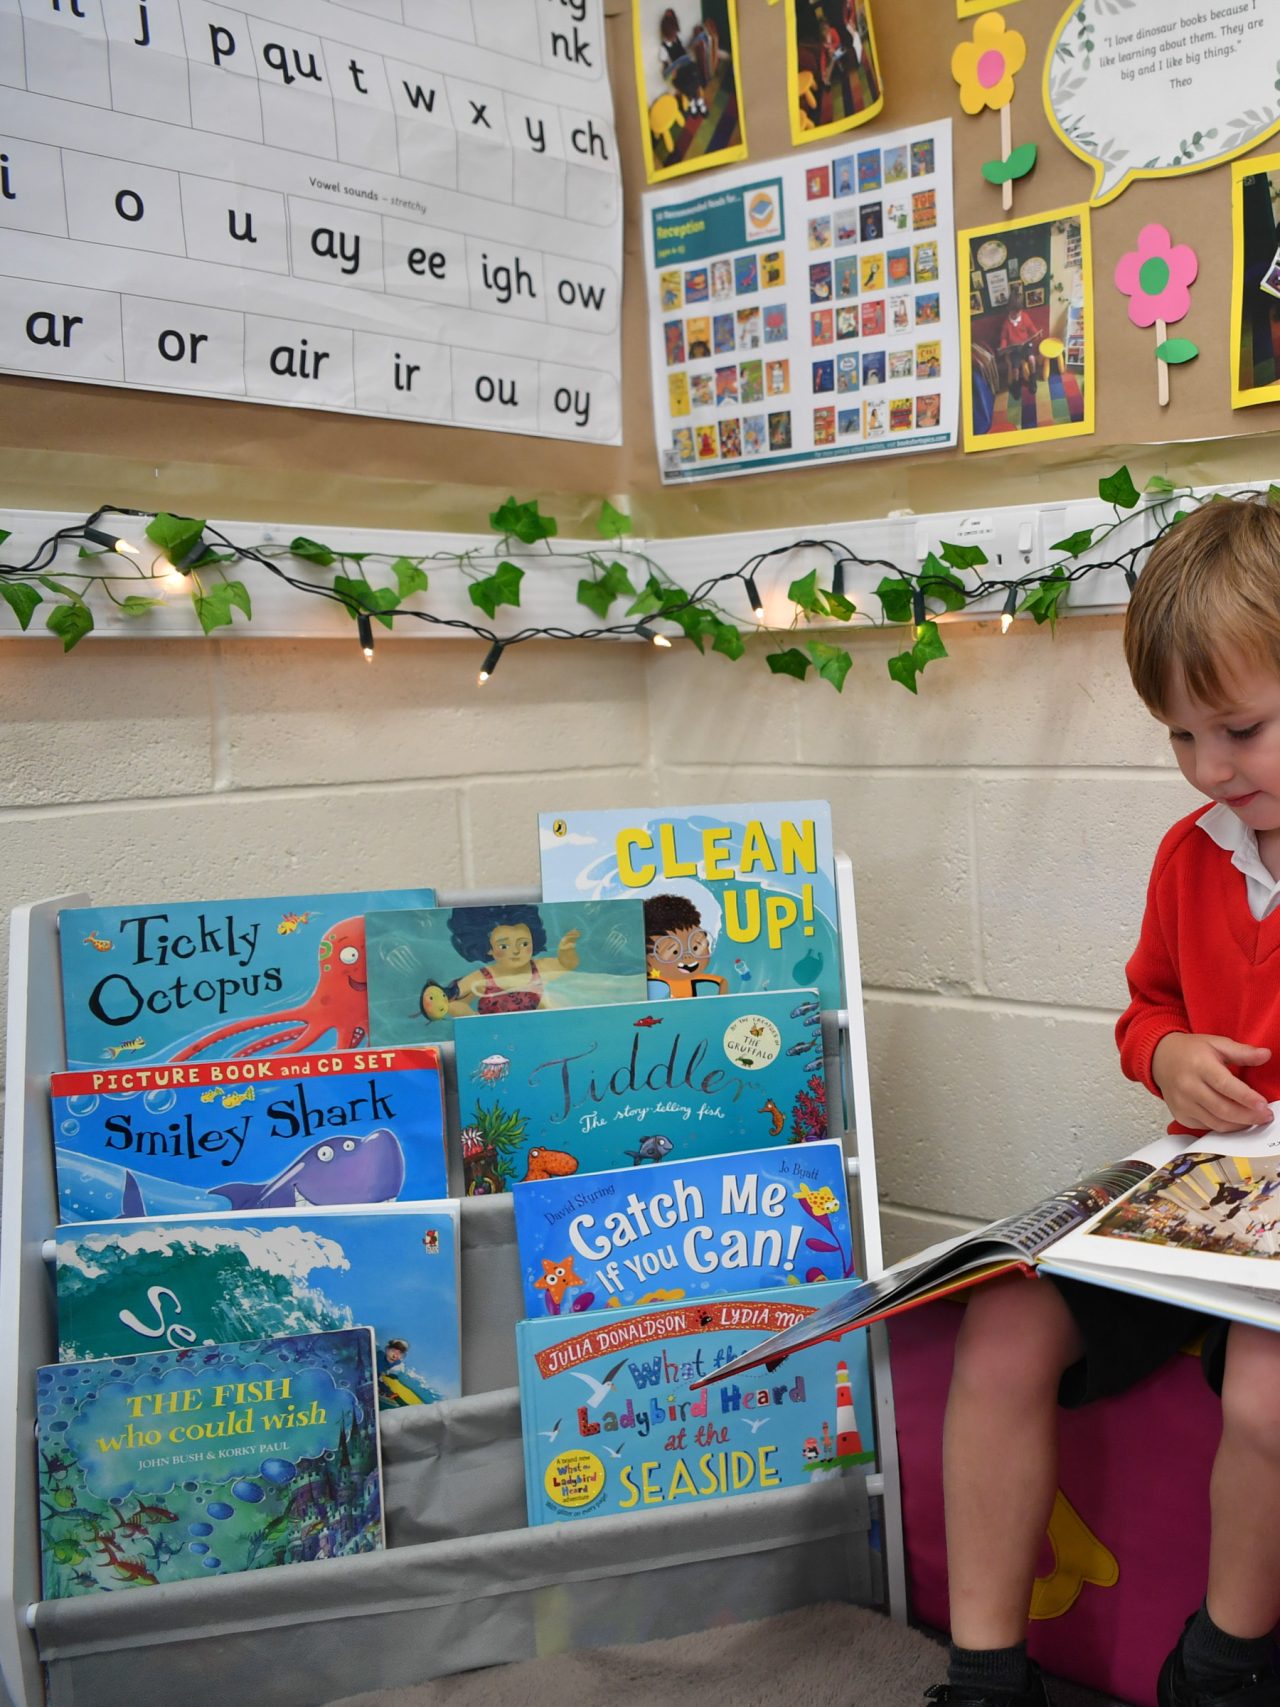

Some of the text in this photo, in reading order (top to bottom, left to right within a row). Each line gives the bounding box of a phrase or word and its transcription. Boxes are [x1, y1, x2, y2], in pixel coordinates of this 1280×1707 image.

[548, 0, 587, 21] g
[1115, 34, 1133, 47] love
[1136, 22, 1177, 41] dinosaur
[1180, 14, 1207, 29] books
[1210, 2, 1249, 21] because
[551, 27, 592, 67] nk
[1100, 18, 1264, 68] like learning about them. They are
[1121, 69, 1135, 82] big
[1138, 61, 1156, 76] and
[1166, 54, 1183, 69] like
[1186, 51, 1201, 65] big
[134, 0, 608, 161] j p qu t w x y ch
[1169, 76, 1193, 90] Theo
[309, 176, 427, 215] Vowel sounds stretchy
[0, 154, 605, 310] i o u ay ee igh ow
[26, 311, 590, 426] ar or air ir ou oy
[615, 819, 817, 888] CLEAN
[119, 914, 261, 967] Tickly
[723, 884, 815, 950] UP!
[88, 967, 283, 1026] Octopus
[727, 1040, 774, 1060] GRUFFALO
[743, 1035, 760, 1047] THE
[92, 1053, 396, 1090] PICTURE BOOK and CD SET
[528, 1032, 750, 1124] Tiddler
[104, 1079, 397, 1167] Smiley Shark
[580, 1110, 607, 1133] The
[696, 1101, 725, 1119] fish
[544, 1203, 576, 1226] David
[778, 1160, 790, 1174] Jo
[568, 1174, 787, 1261] Catch Me
[595, 1261, 625, 1295] If
[683, 1225, 804, 1274] Can!
[548, 1338, 593, 1372] JULIA
[596, 1314, 688, 1349] DONALDSON
[719, 1307, 770, 1325] LYDIA
[627, 1348, 706, 1390] What
[126, 1377, 293, 1418] THE FISH
[577, 1375, 807, 1437] Ladybird Heard
[96, 1400, 327, 1453] who could wish
[664, 1421, 731, 1452] at the
[138, 1442, 290, 1471] JOHN BUSH & KORKY PAUL
[553, 1472, 597, 1488] Ladybird
[557, 1463, 581, 1476] What
[618, 1445, 783, 1509] SEASIDE
[562, 1485, 588, 1496] Heard
